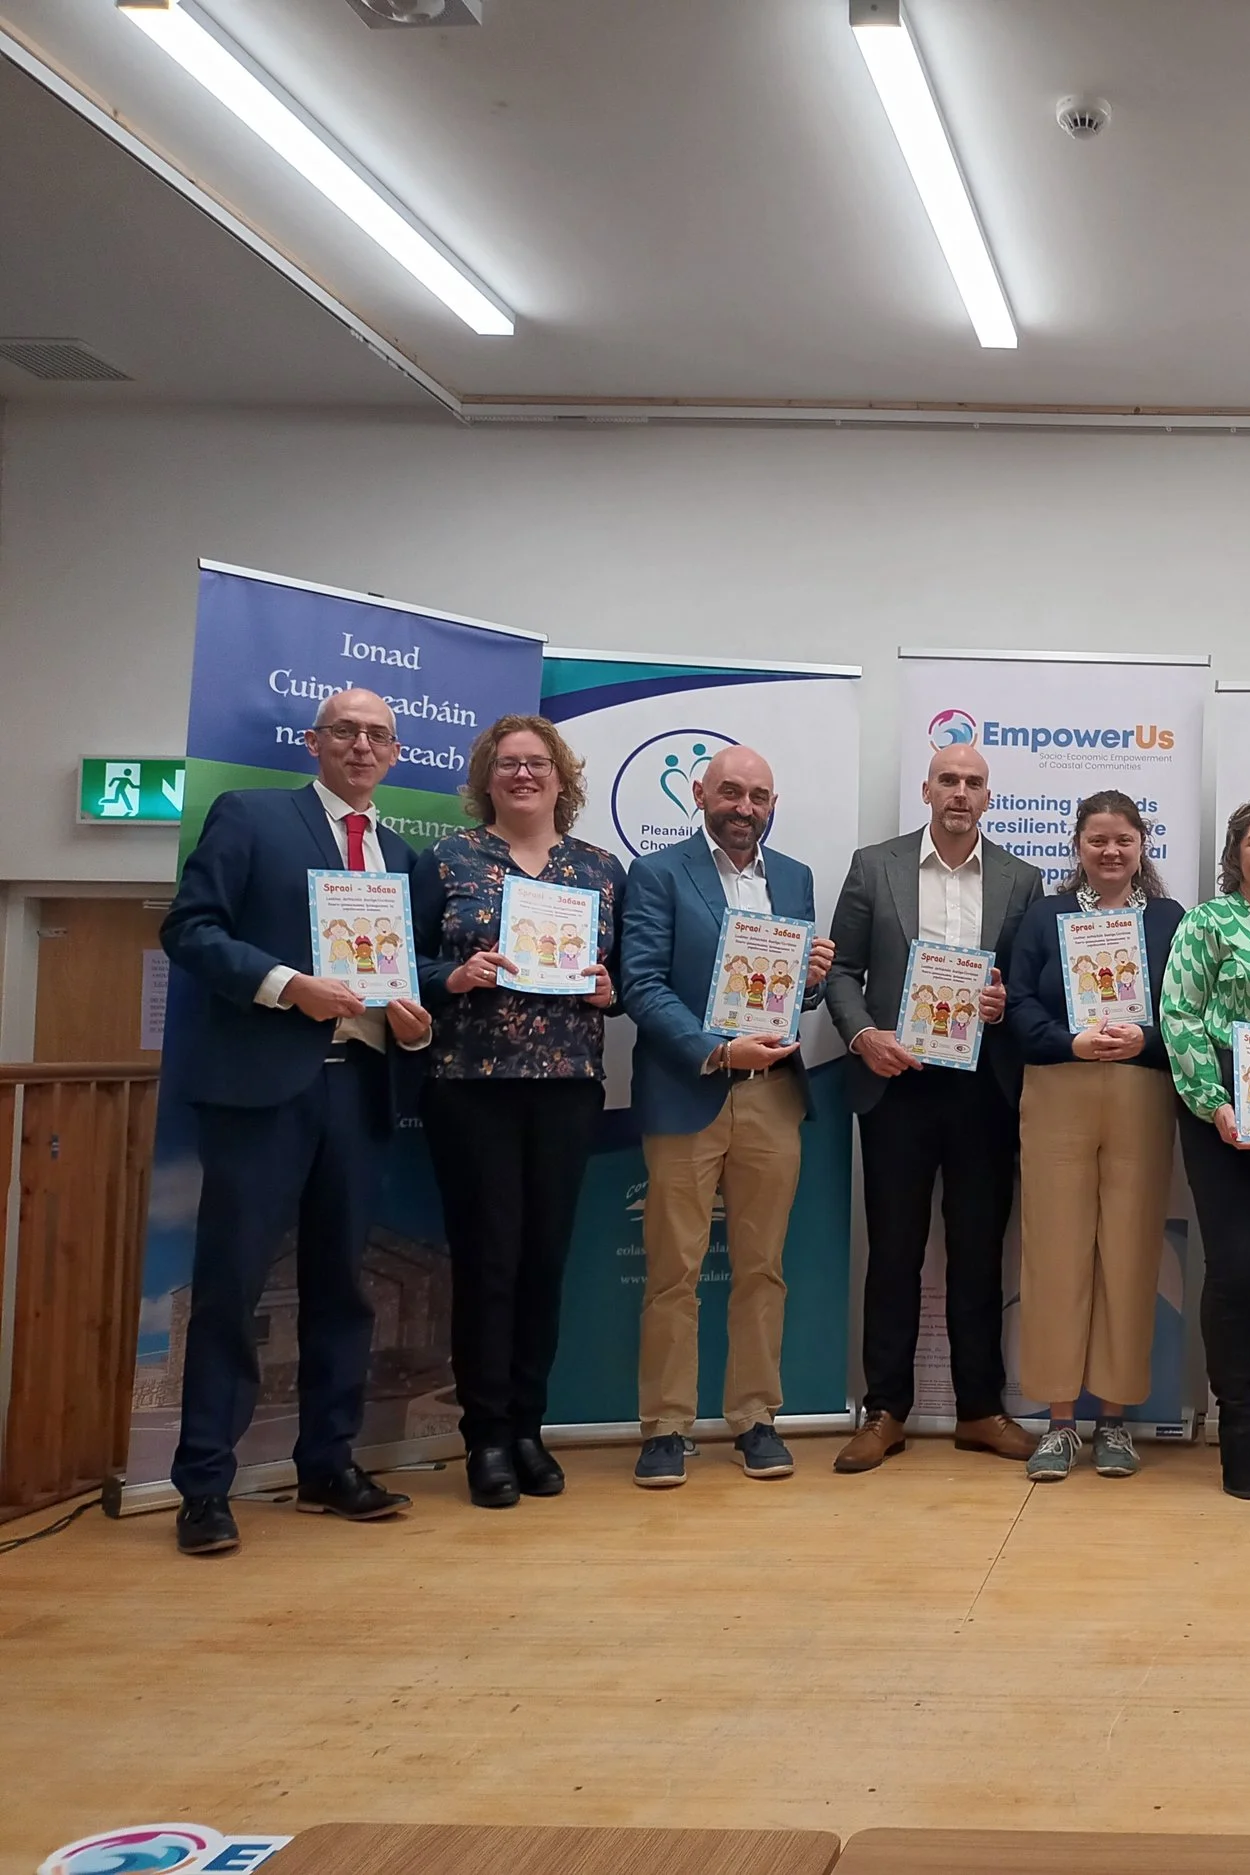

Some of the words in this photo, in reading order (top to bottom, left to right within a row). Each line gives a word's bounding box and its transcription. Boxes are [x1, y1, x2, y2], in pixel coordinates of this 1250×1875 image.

[340, 632, 422, 671] Ionad
[983, 721, 1175, 752] EmpowerUs
[1039, 752, 1108, 761] Socio-Economic
[1111, 753, 1172, 763] Empowerment
[1039, 761, 1047, 769] of
[1050, 761, 1083, 769] Coastal
[1085, 762, 1141, 771] Communities
[988, 794, 1071, 816] sitioning
[641, 824, 693, 836] Pleanáil
